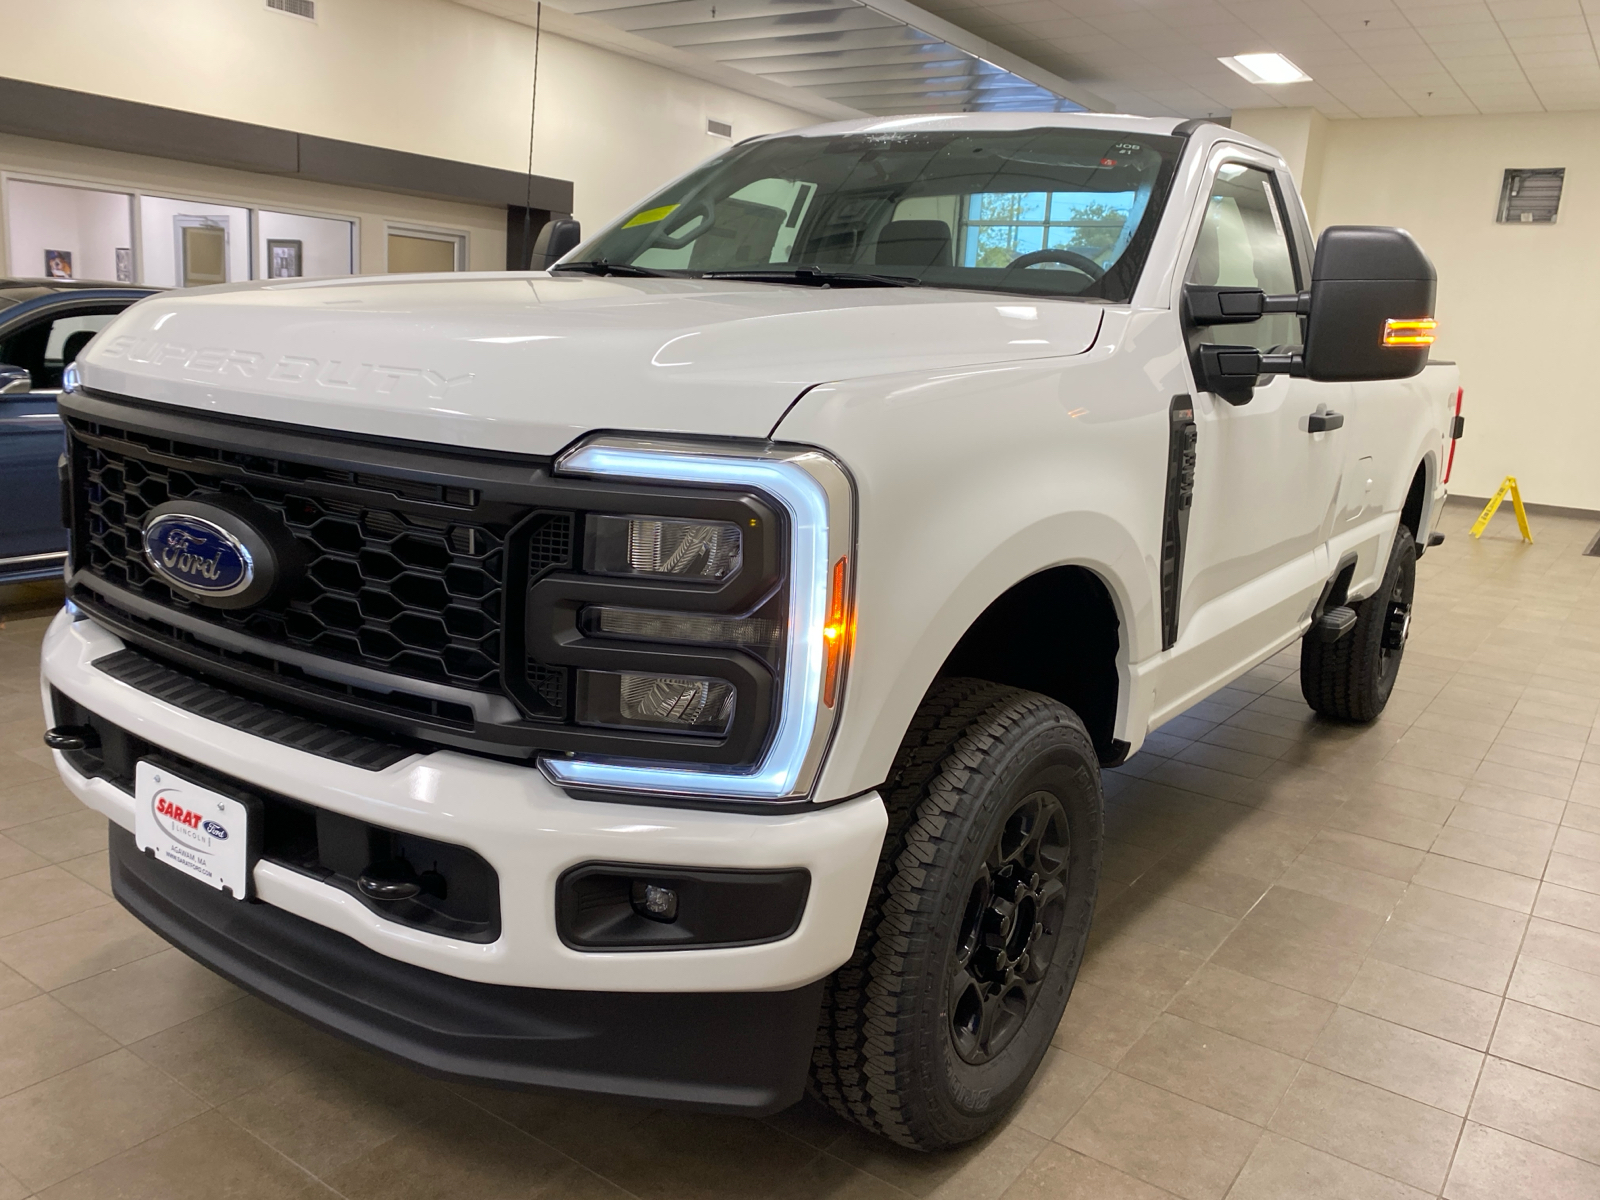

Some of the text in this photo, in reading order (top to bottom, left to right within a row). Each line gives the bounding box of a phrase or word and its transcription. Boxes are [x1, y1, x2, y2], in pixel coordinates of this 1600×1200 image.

[101, 335, 476, 399] SUPER DUTY
[162, 528, 222, 580] Ford
[156, 797, 225, 838] SARAT Ford
[176, 827, 206, 843] LINCOLN
